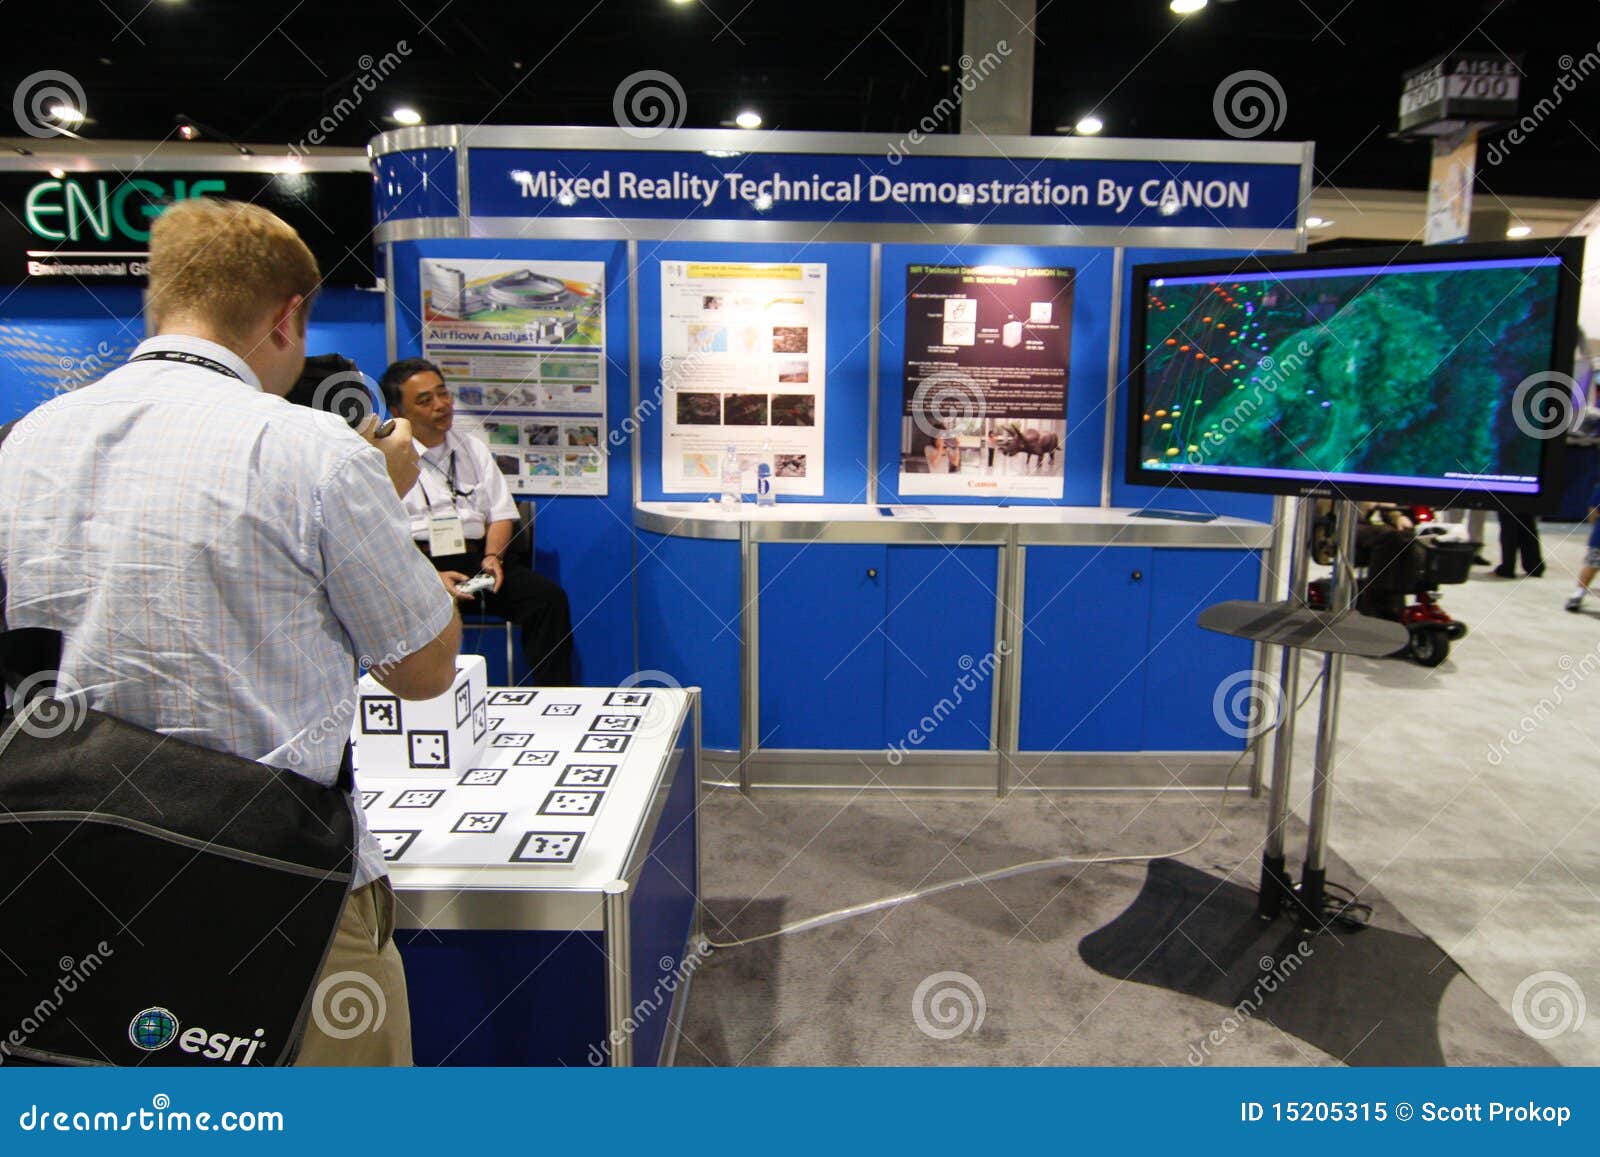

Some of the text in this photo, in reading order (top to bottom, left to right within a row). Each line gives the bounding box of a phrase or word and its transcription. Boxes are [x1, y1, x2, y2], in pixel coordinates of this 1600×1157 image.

[1456, 60, 1514, 75] AISLE
[1461, 76, 1509, 97] 700
[521, 171, 1249, 213] Mixed Reality Technical Demonstration By CANON
[28, 261, 127, 276] Environmental
[429, 330, 534, 344] Airflow Analyst
[179, 1027, 265, 1065] esri
